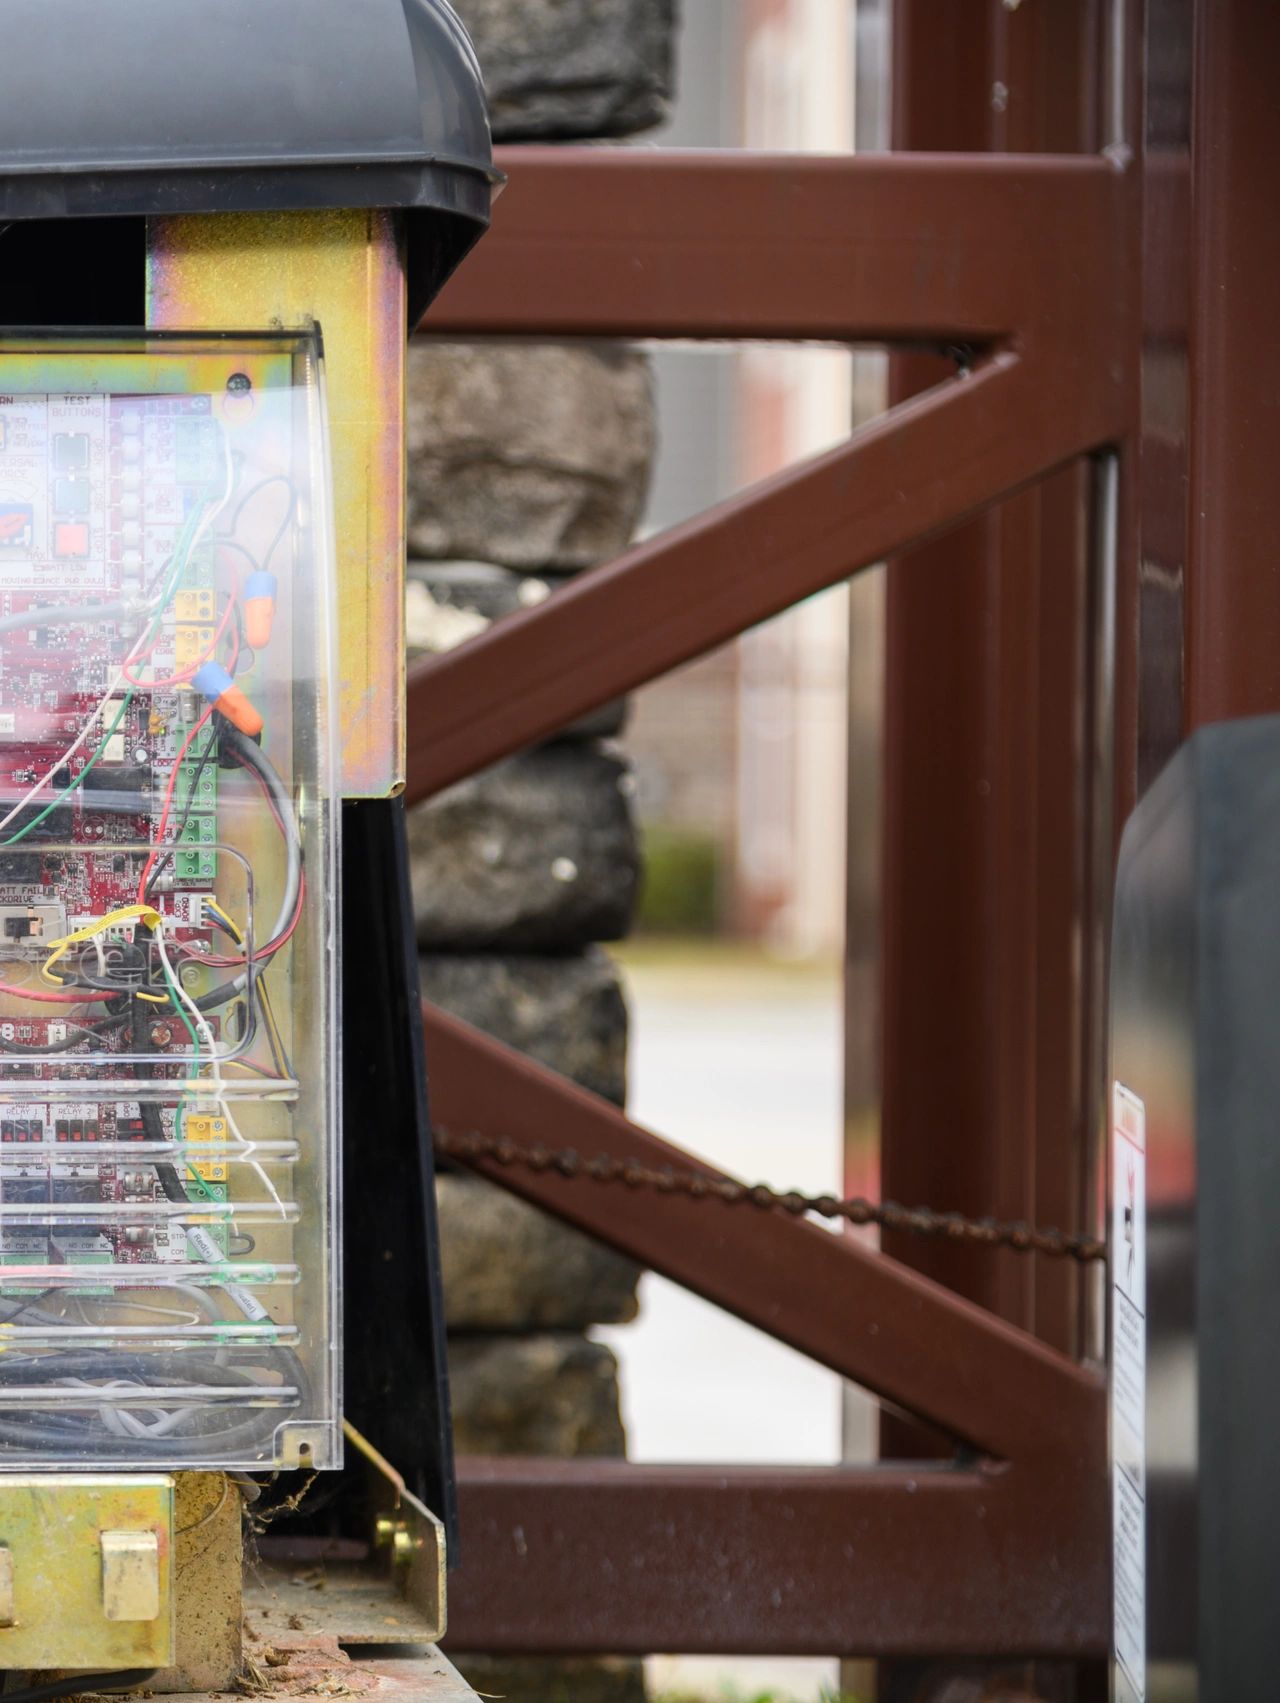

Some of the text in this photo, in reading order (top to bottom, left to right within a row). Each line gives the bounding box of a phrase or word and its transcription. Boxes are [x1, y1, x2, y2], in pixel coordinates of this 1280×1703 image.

[63, 395, 91, 405] TEST
[52, 407, 102, 417] BUTTONS
[26, 551, 46, 561] MAX
[6, 1108, 32, 1116] RELAY
[58, 1108, 82, 1116] RELAY
